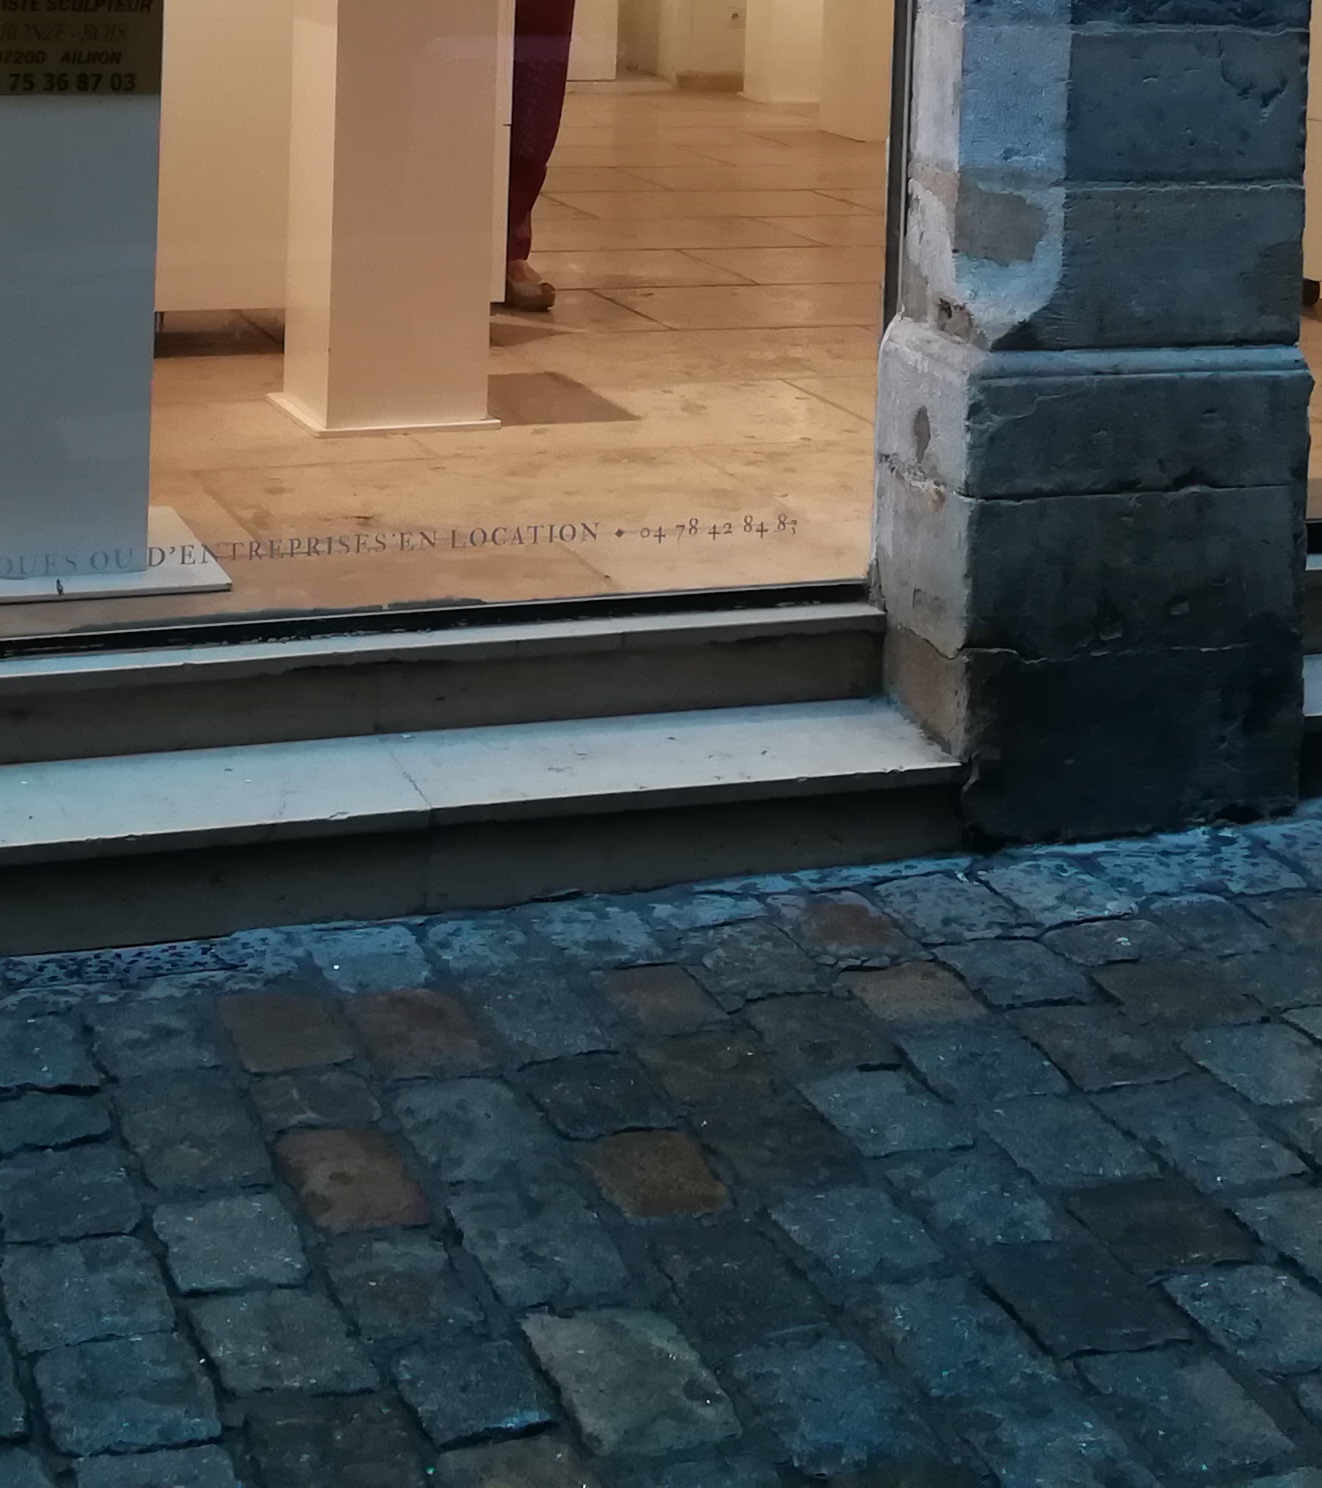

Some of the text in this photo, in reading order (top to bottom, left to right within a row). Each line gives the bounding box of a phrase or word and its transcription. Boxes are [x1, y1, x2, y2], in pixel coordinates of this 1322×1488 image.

[59, 50, 123, 65] AILHON
[9, 72, 35, 92] 75
[43, 73, 70, 92] 36
[76, 73, 103, 92] 87
[111, 73, 137, 92] 03
[88, 548, 135, 572] OU
[146, 532, 387, 568] D'ENTREPRISES
[398, 530, 437, 552] EN
[450, 521, 600, 550] LOCATION
[639, 525, 667, 544] 04
[675, 517, 699, 541] 78
[707, 522, 733, 541] 42
[743, 514, 769, 540] 84
